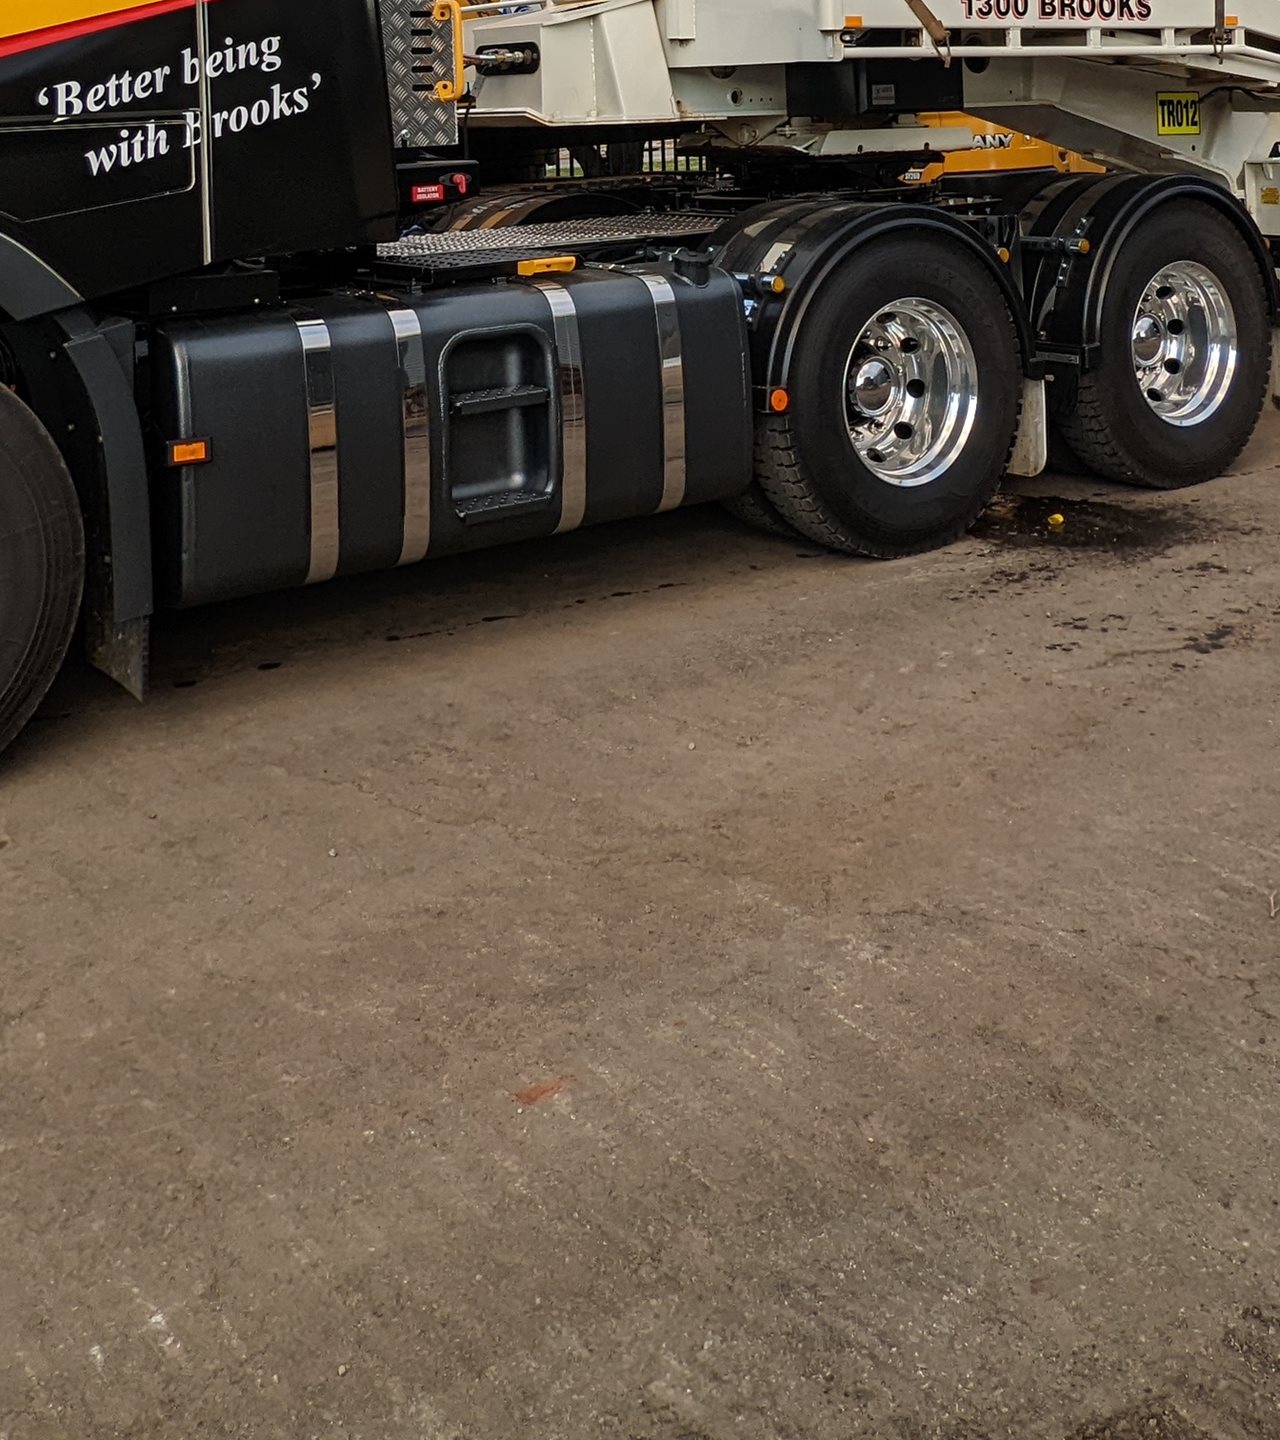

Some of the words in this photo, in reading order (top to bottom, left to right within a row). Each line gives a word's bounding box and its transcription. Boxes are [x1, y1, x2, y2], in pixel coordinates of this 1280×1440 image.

[180, 35, 282, 85] being
[84, 120, 170, 177] with
[972, 133, 1015, 149] ANY
